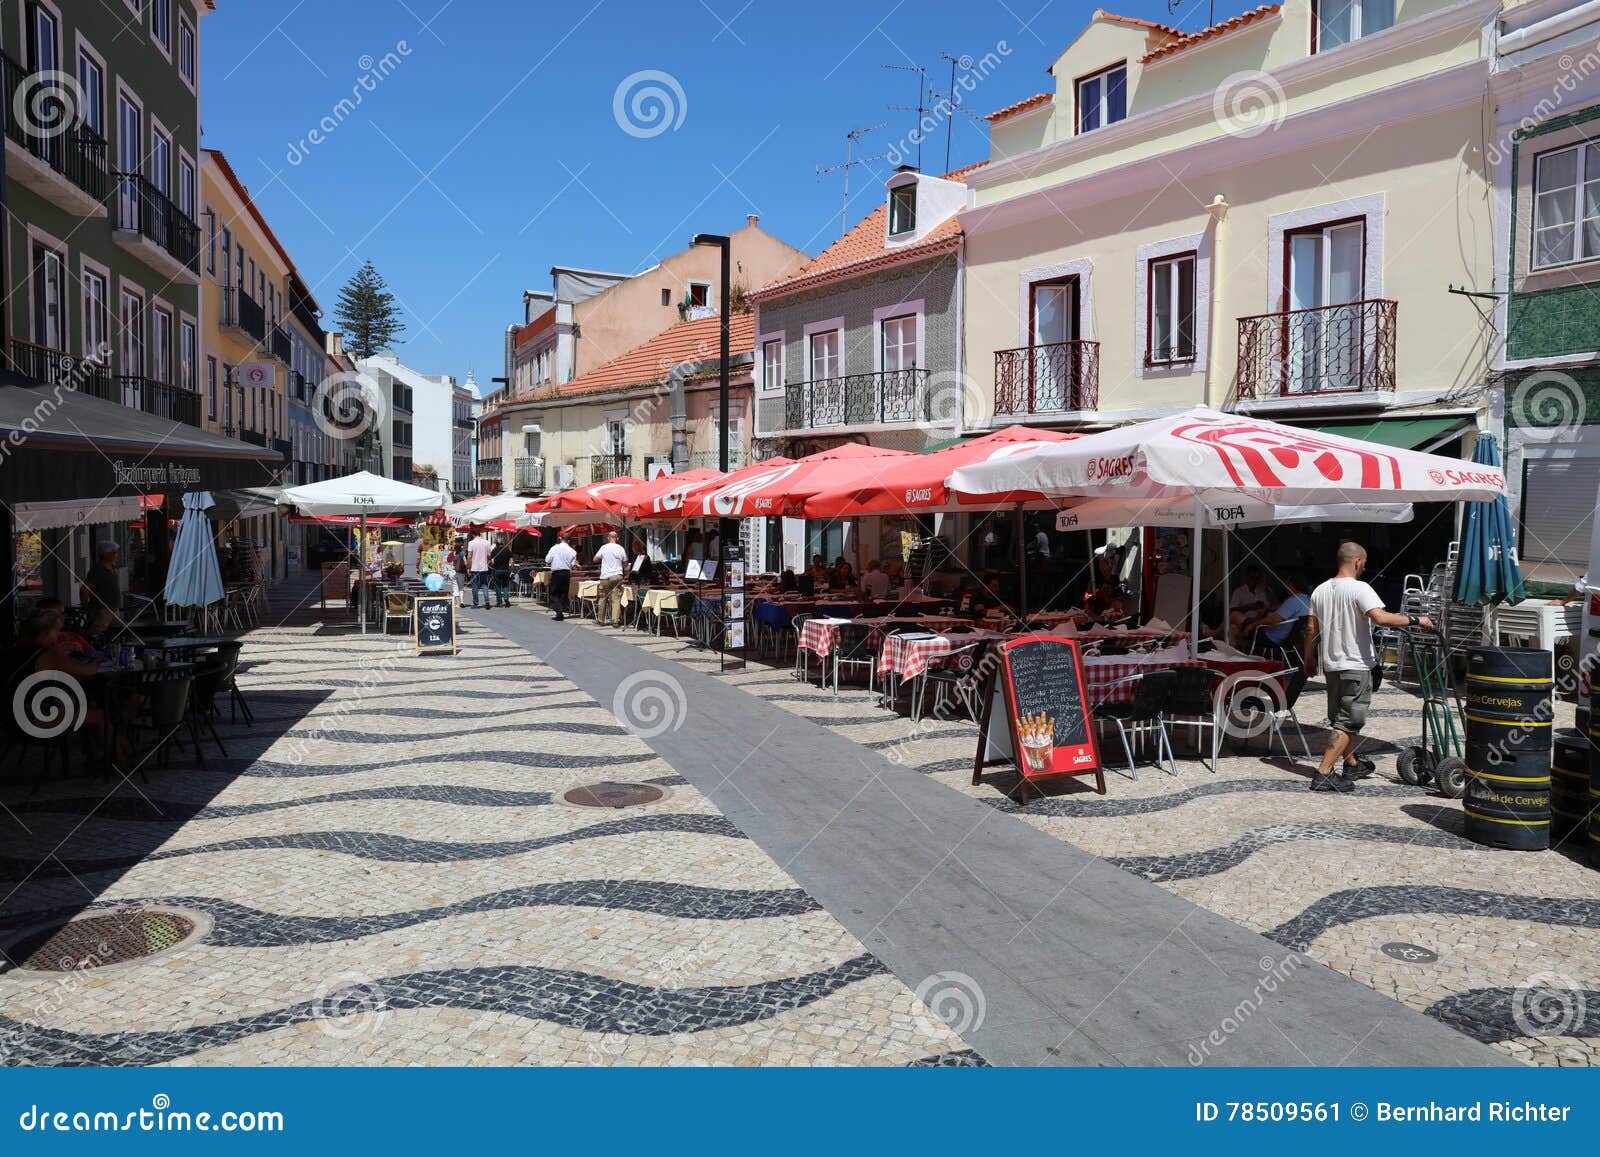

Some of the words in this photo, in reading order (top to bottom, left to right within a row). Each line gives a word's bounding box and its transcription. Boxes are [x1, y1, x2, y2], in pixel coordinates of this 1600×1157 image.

[1097, 455, 1135, 480] SAGRES
[1445, 469, 1504, 490] SAGRES
[912, 488, 931, 502] SAGRES
[1214, 505, 1246, 521] TOFA
[1059, 514, 1079, 527] TOFA
[1481, 696, 1522, 708] Cervejas
[1073, 754, 1093, 764] SAGRES
[1500, 794, 1514, 804] de
